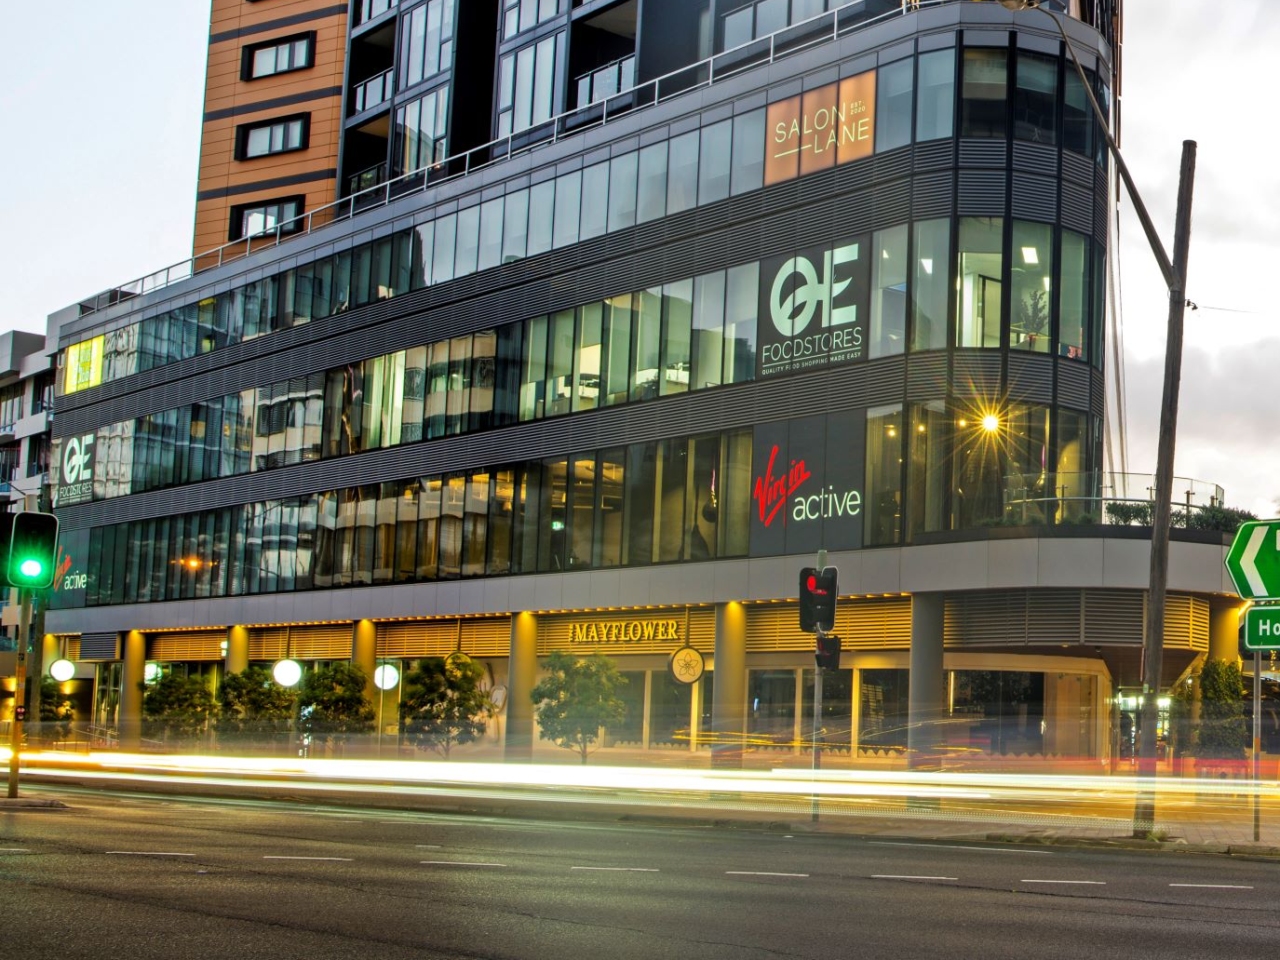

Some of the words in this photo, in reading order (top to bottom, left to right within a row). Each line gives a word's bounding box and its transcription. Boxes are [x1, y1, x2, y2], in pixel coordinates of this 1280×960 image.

[774, 102, 846, 143] SALON
[850, 106, 866, 115] 2020
[814, 118, 870, 154] LANE
[762, 366, 785, 376] QUALITY
[801, 358, 827, 367] SHOPPING
[847, 352, 861, 360] EASY
[754, 445, 811, 528] Virgin
[793, 485, 861, 521] active
[64, 570, 88, 590] active
[574, 620, 679, 642] MAYFLOWER
